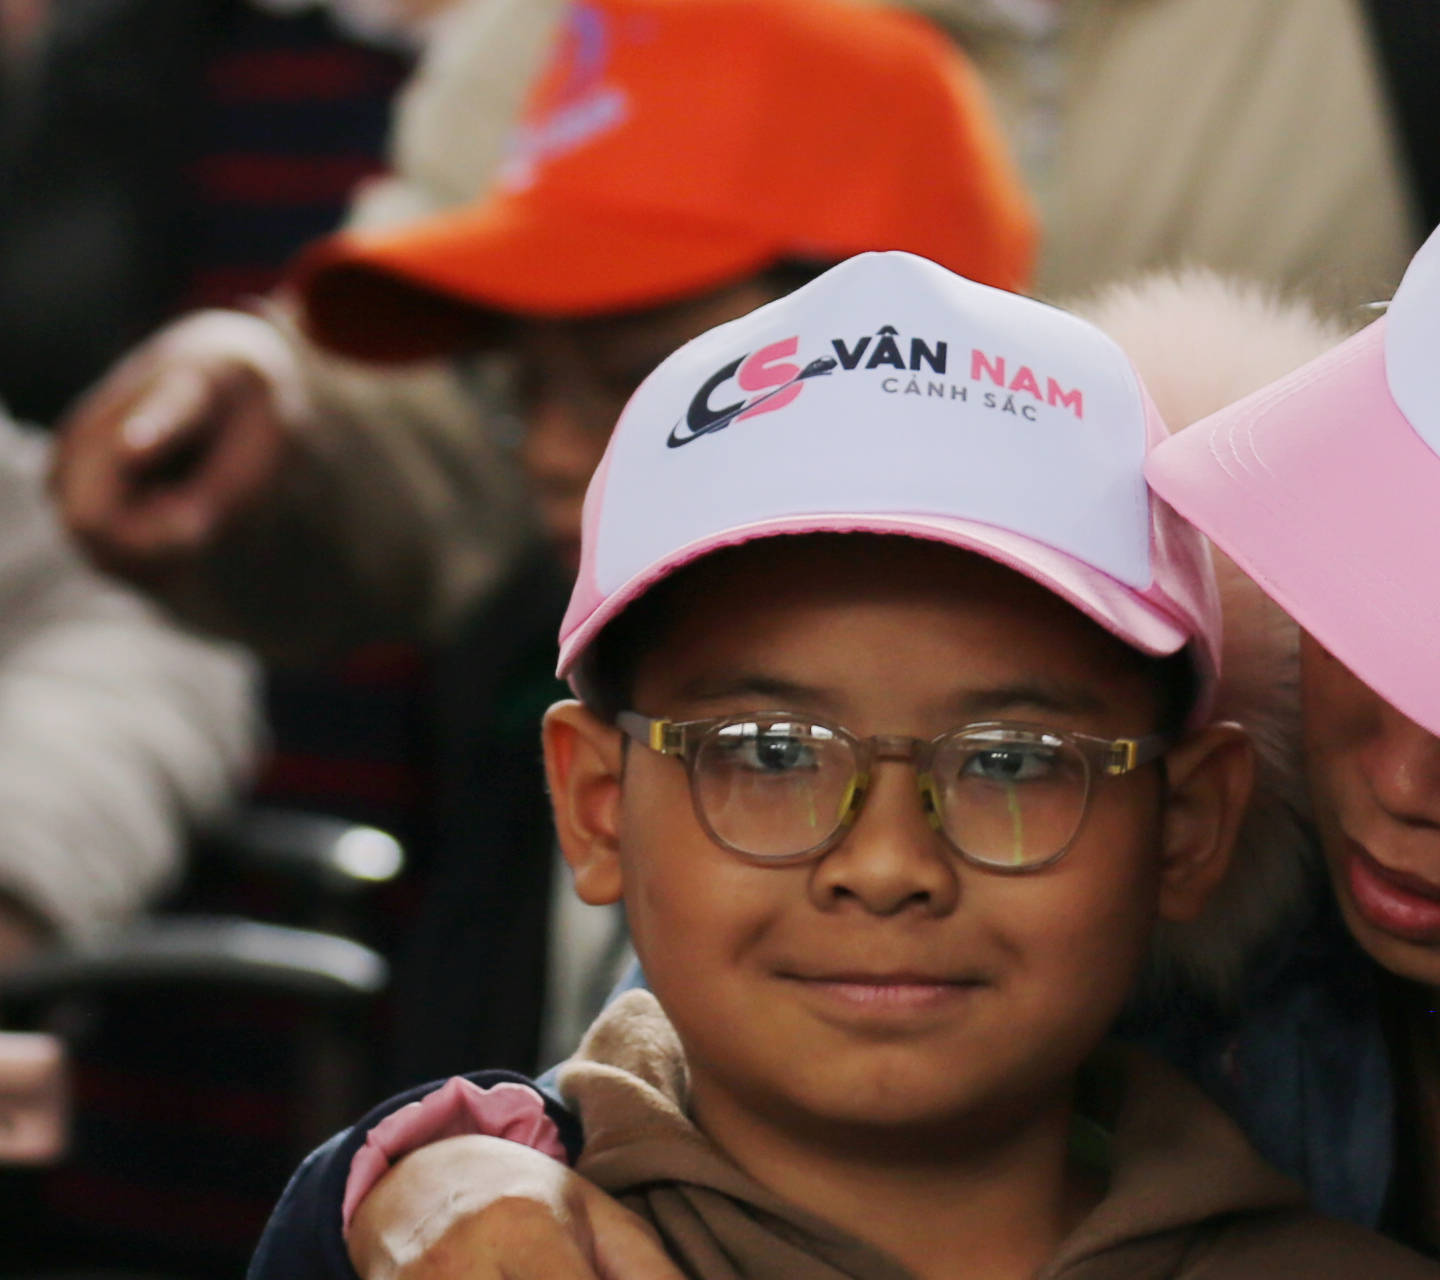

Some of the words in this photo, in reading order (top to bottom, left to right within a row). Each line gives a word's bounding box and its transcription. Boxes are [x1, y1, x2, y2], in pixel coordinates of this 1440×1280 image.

[681, 334, 806, 437] CS
[831, 324, 948, 375] VÂN
[970, 348, 1084, 420] NAM
